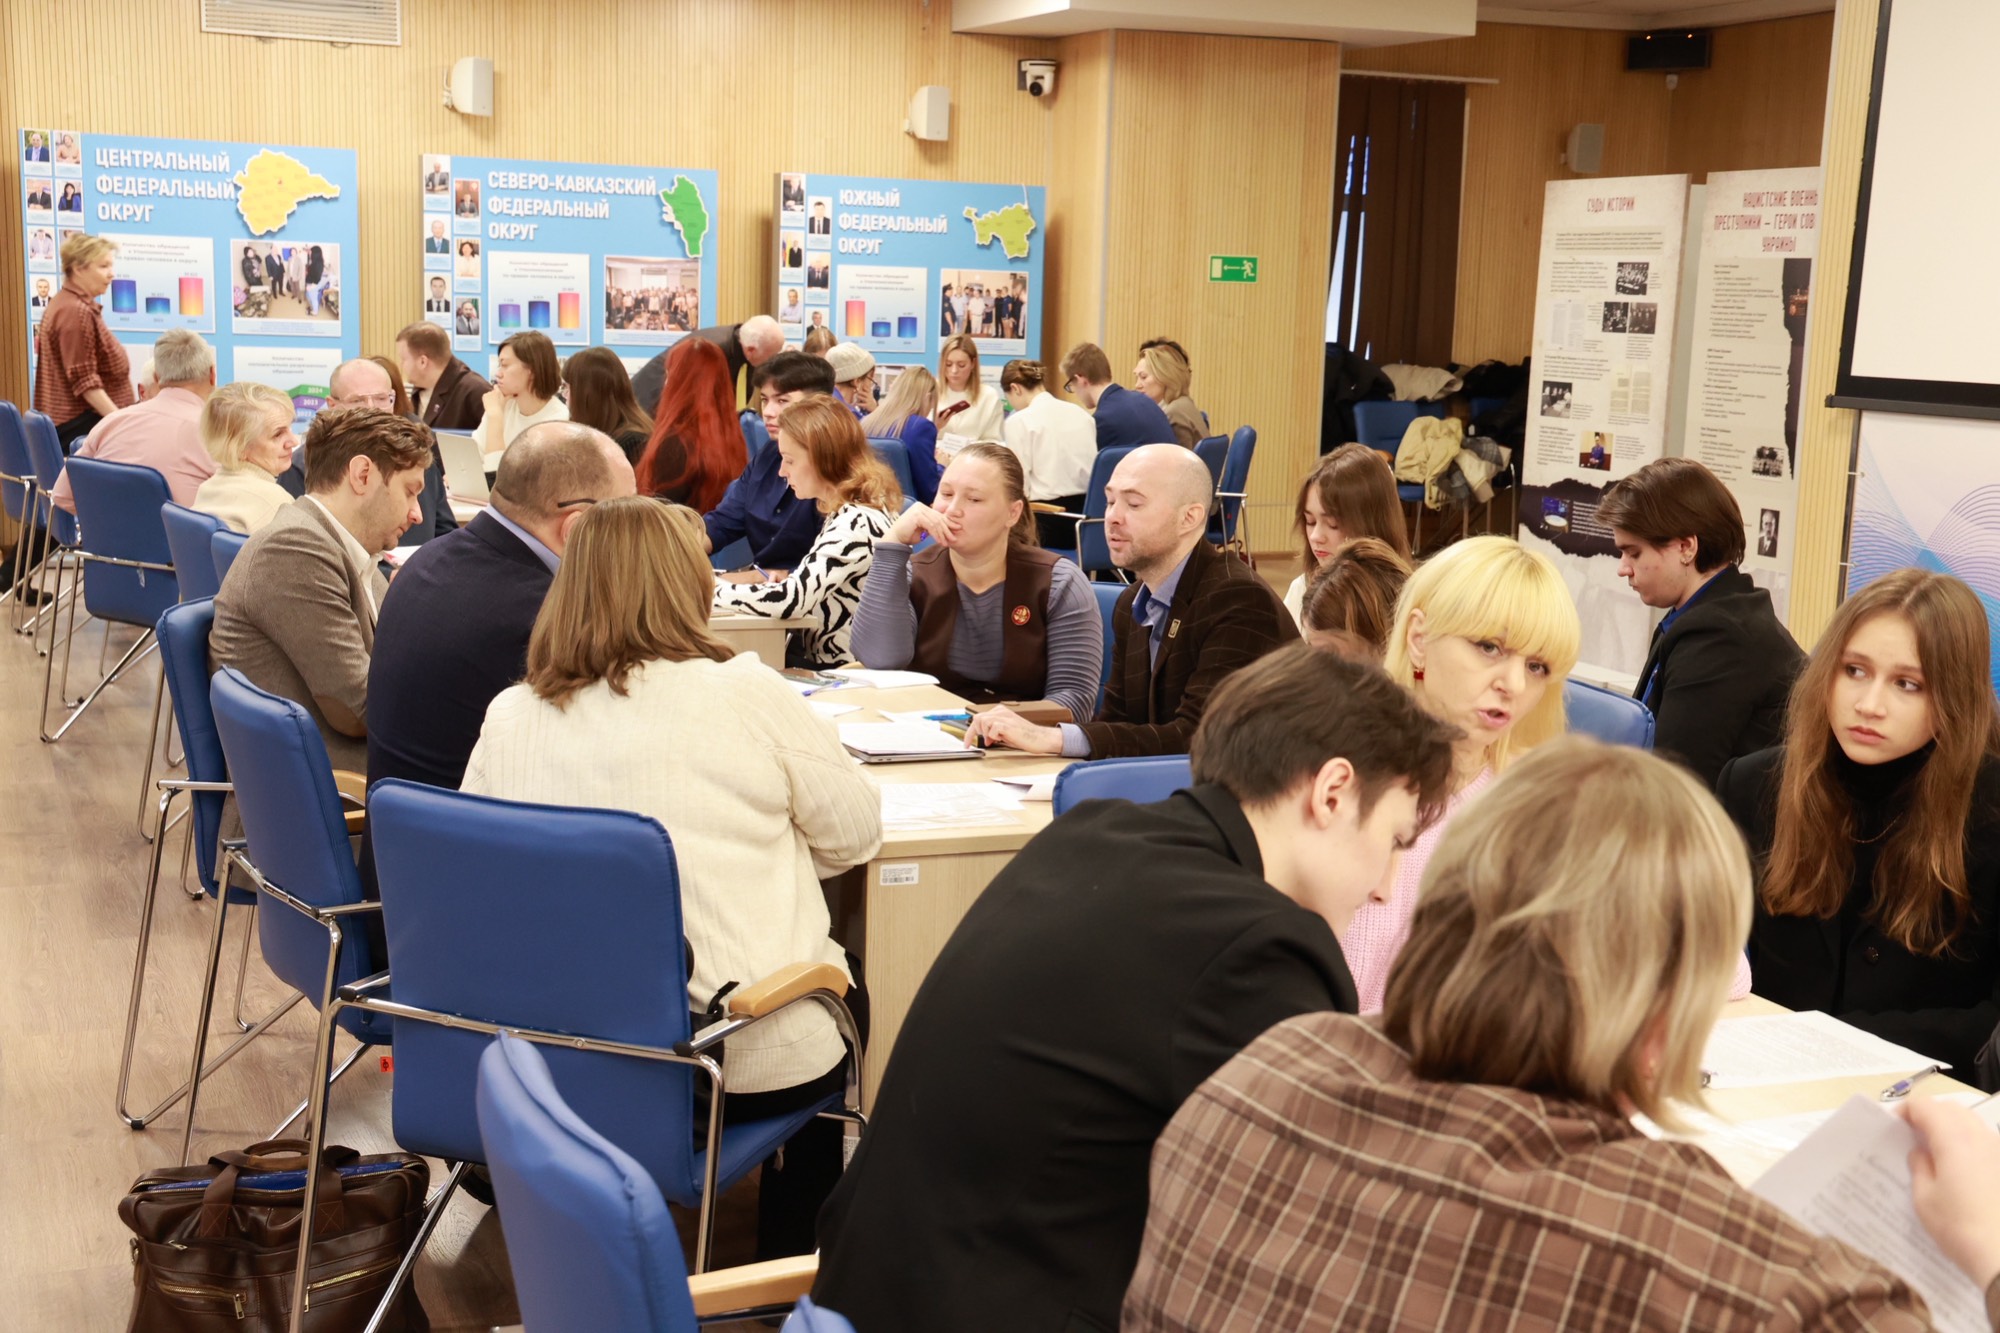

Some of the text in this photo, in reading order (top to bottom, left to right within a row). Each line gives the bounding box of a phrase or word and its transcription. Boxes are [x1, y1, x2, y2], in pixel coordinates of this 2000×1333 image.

[95, 147, 231, 172] ЦЕНТРАЛЬНЫЙ
[96, 174, 236, 200] ФЕДЕРАЛЬНЫЙ
[488, 171, 657, 196] СЕВЕРО-КАВКАЗСКИЙ
[488, 197, 610, 218] ФЕДЕРАЛЬНЫЙ
[840, 188, 900, 207] ЮЖНЫЙ
[1587, 196, 1636, 213] СУДЫ ИСТОРИИ
[1743, 191, 1788, 208] НАЦИСТСКИЕ
[97, 202, 155, 222] ОКРУГ
[1713, 214, 1762, 230] ПРЕСТУПНИКИ
[1774, 213, 1798, 229] ГЕРОИ
[488, 221, 539, 241] ОКРУГ
[839, 213, 948, 233] ФЕДЕРАЛЬНЫЙ
[839, 237, 883, 254] ОКРУГ
